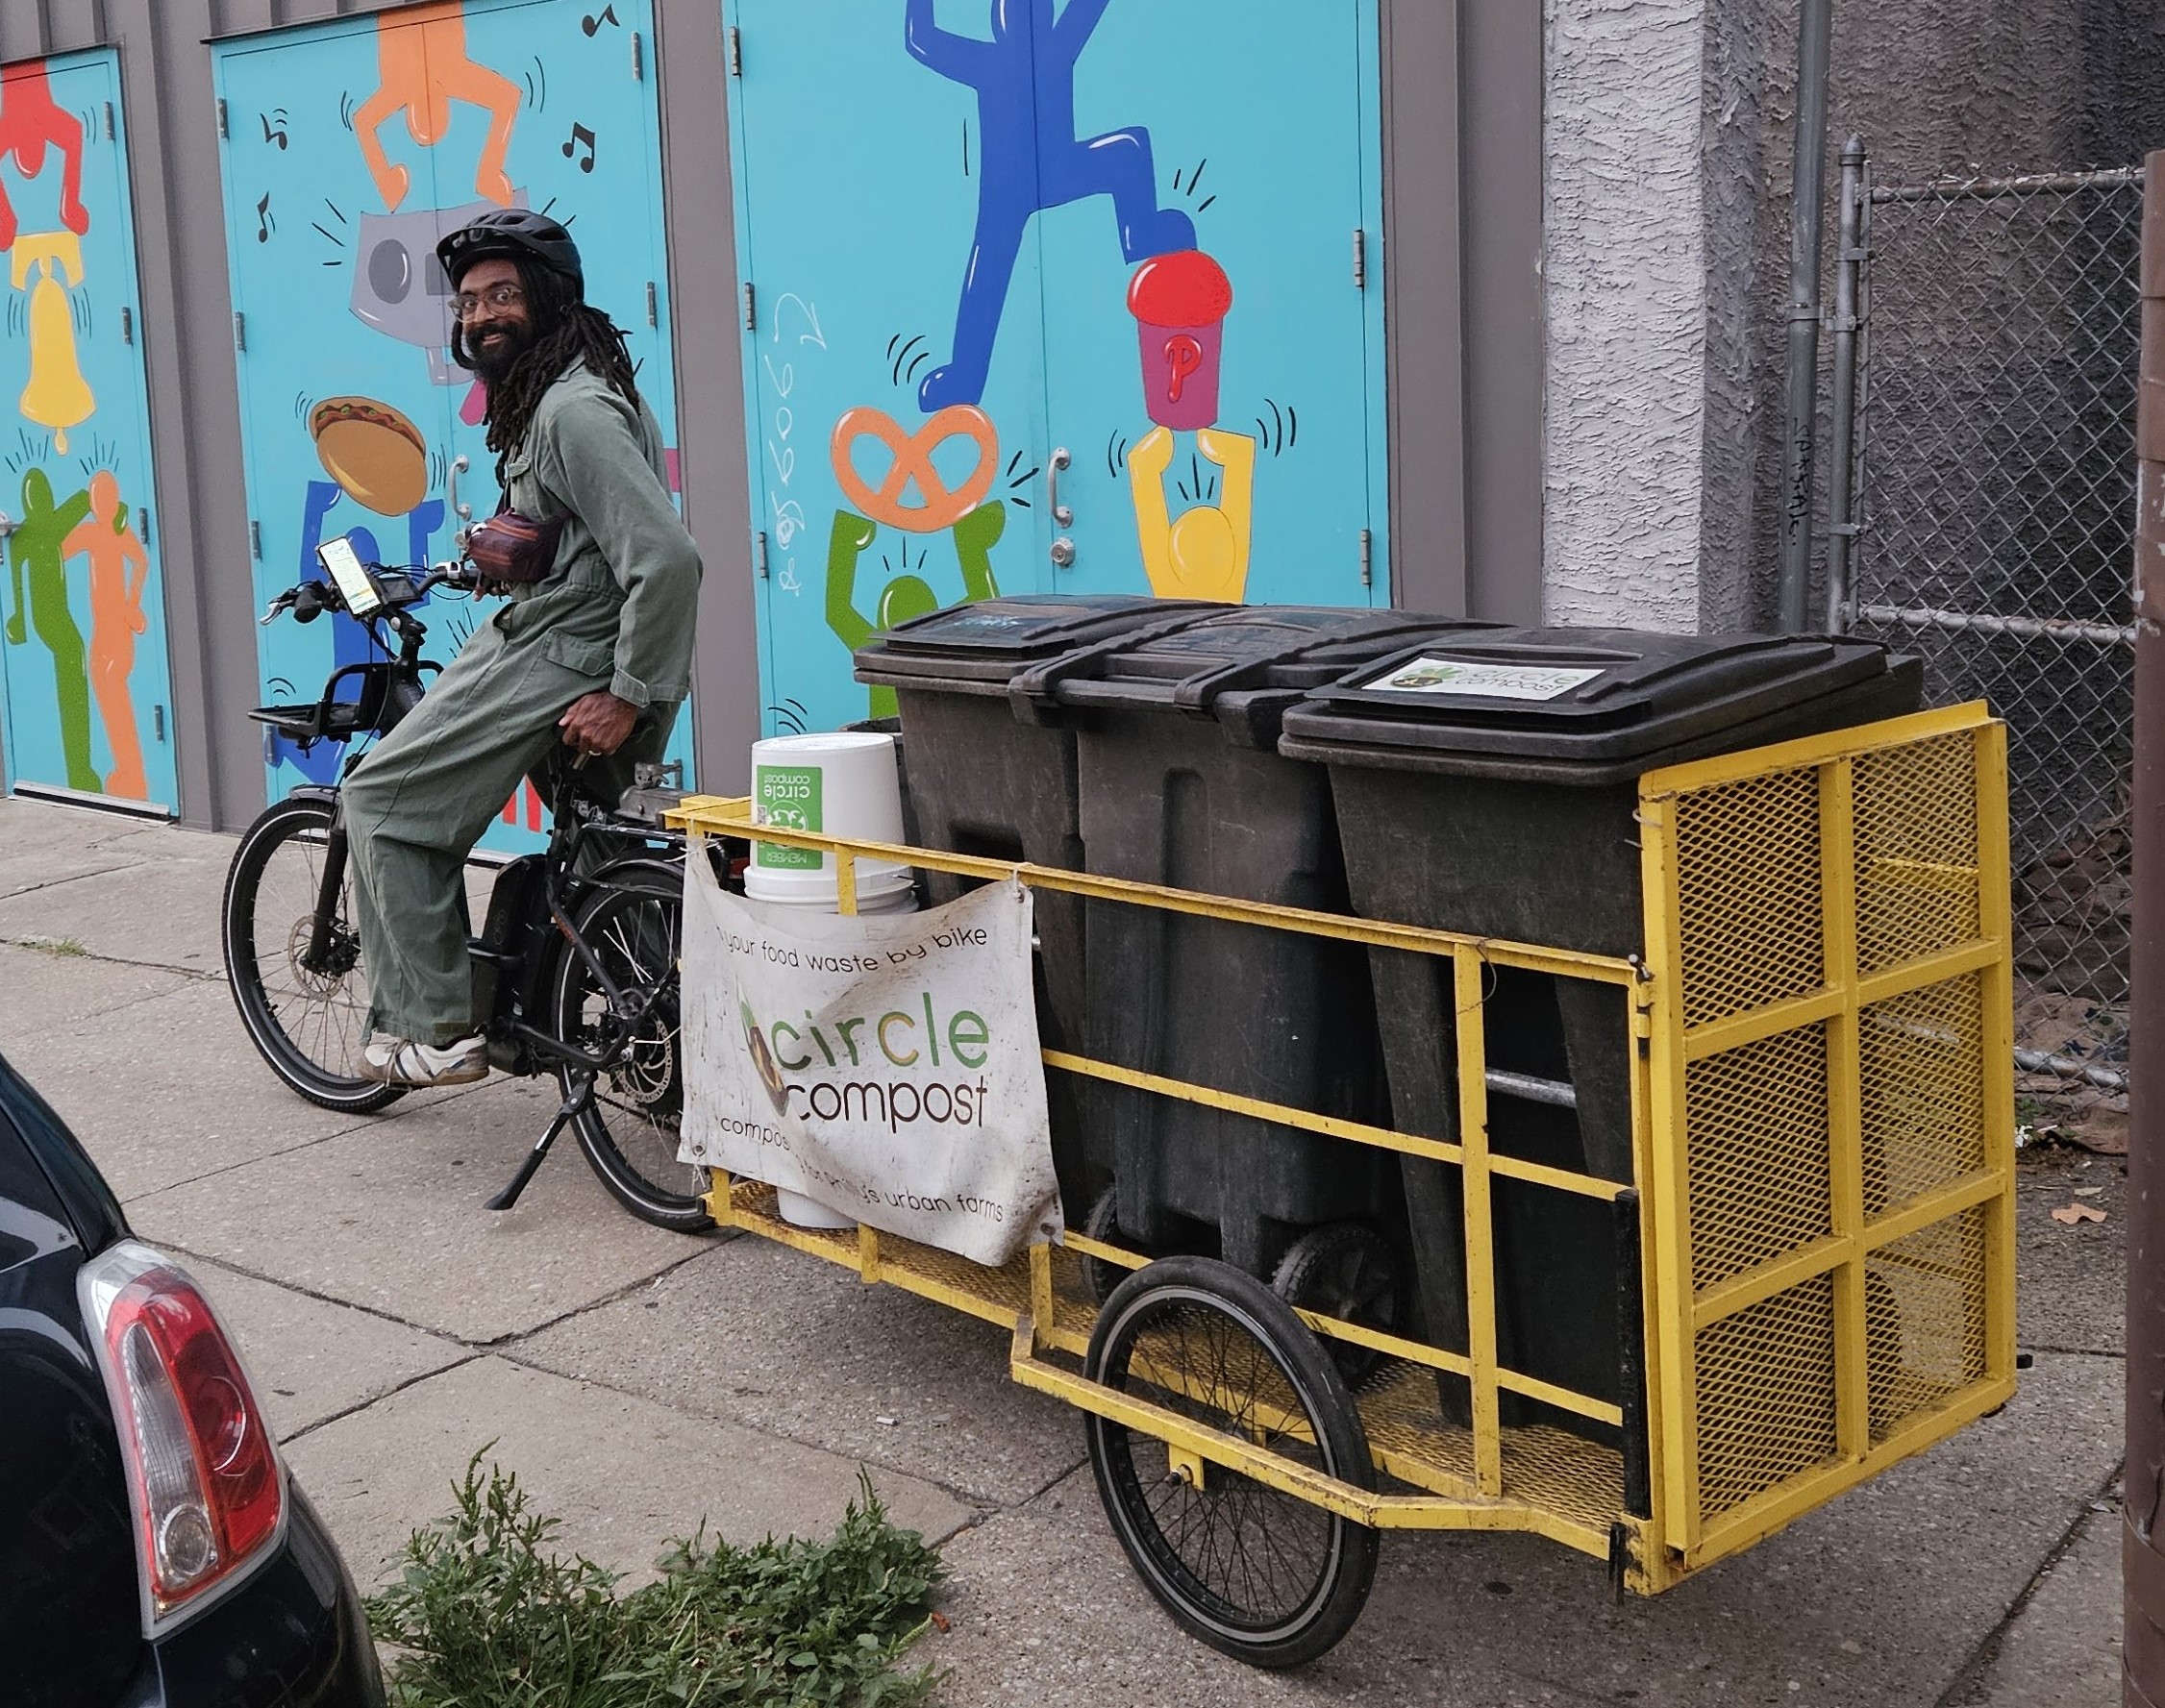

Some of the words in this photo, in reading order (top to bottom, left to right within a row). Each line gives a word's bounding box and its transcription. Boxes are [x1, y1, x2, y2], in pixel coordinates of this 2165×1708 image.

[1456, 678, 1563, 692] compost
[1472, 670, 1580, 684] circle
[764, 774, 810, 785] compost
[764, 783, 810, 802] circle
[768, 852, 807, 864] MEMBER
[724, 930, 755, 955] your
[761, 940, 799, 968] food
[806, 954, 879, 973] waste
[886, 945, 927, 964] by
[932, 927, 987, 949] bike
[771, 992, 989, 1071] circle
[786, 1075, 988, 1134] compost
[720, 1117, 790, 1151] compos
[884, 1186, 952, 1212] urban
[957, 1194, 1004, 1223] farms
